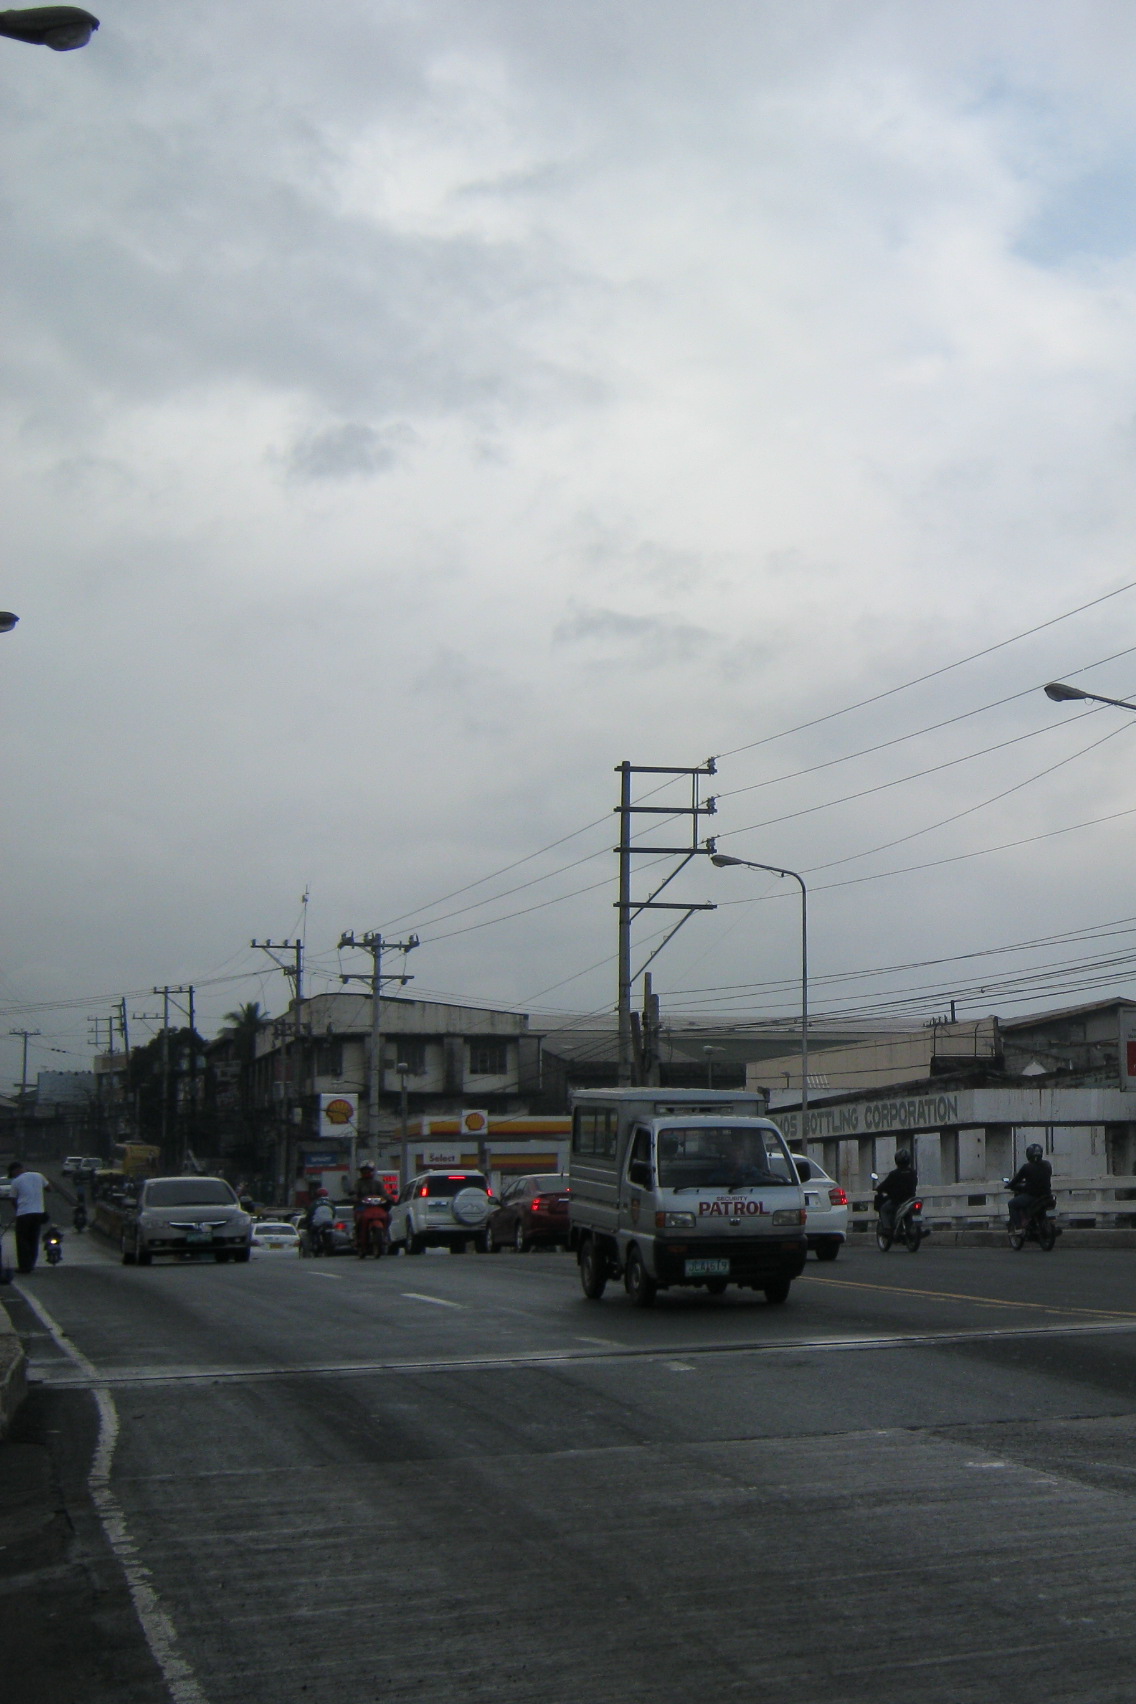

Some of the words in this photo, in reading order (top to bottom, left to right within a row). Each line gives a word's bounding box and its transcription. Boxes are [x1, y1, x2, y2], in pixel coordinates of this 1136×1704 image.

[803, 1106, 859, 1135] BOTTLING
[864, 1095, 959, 1131] CORPORATION
[429, 1153, 455, 1162] Select
[698, 1201, 770, 1216] PATROL
